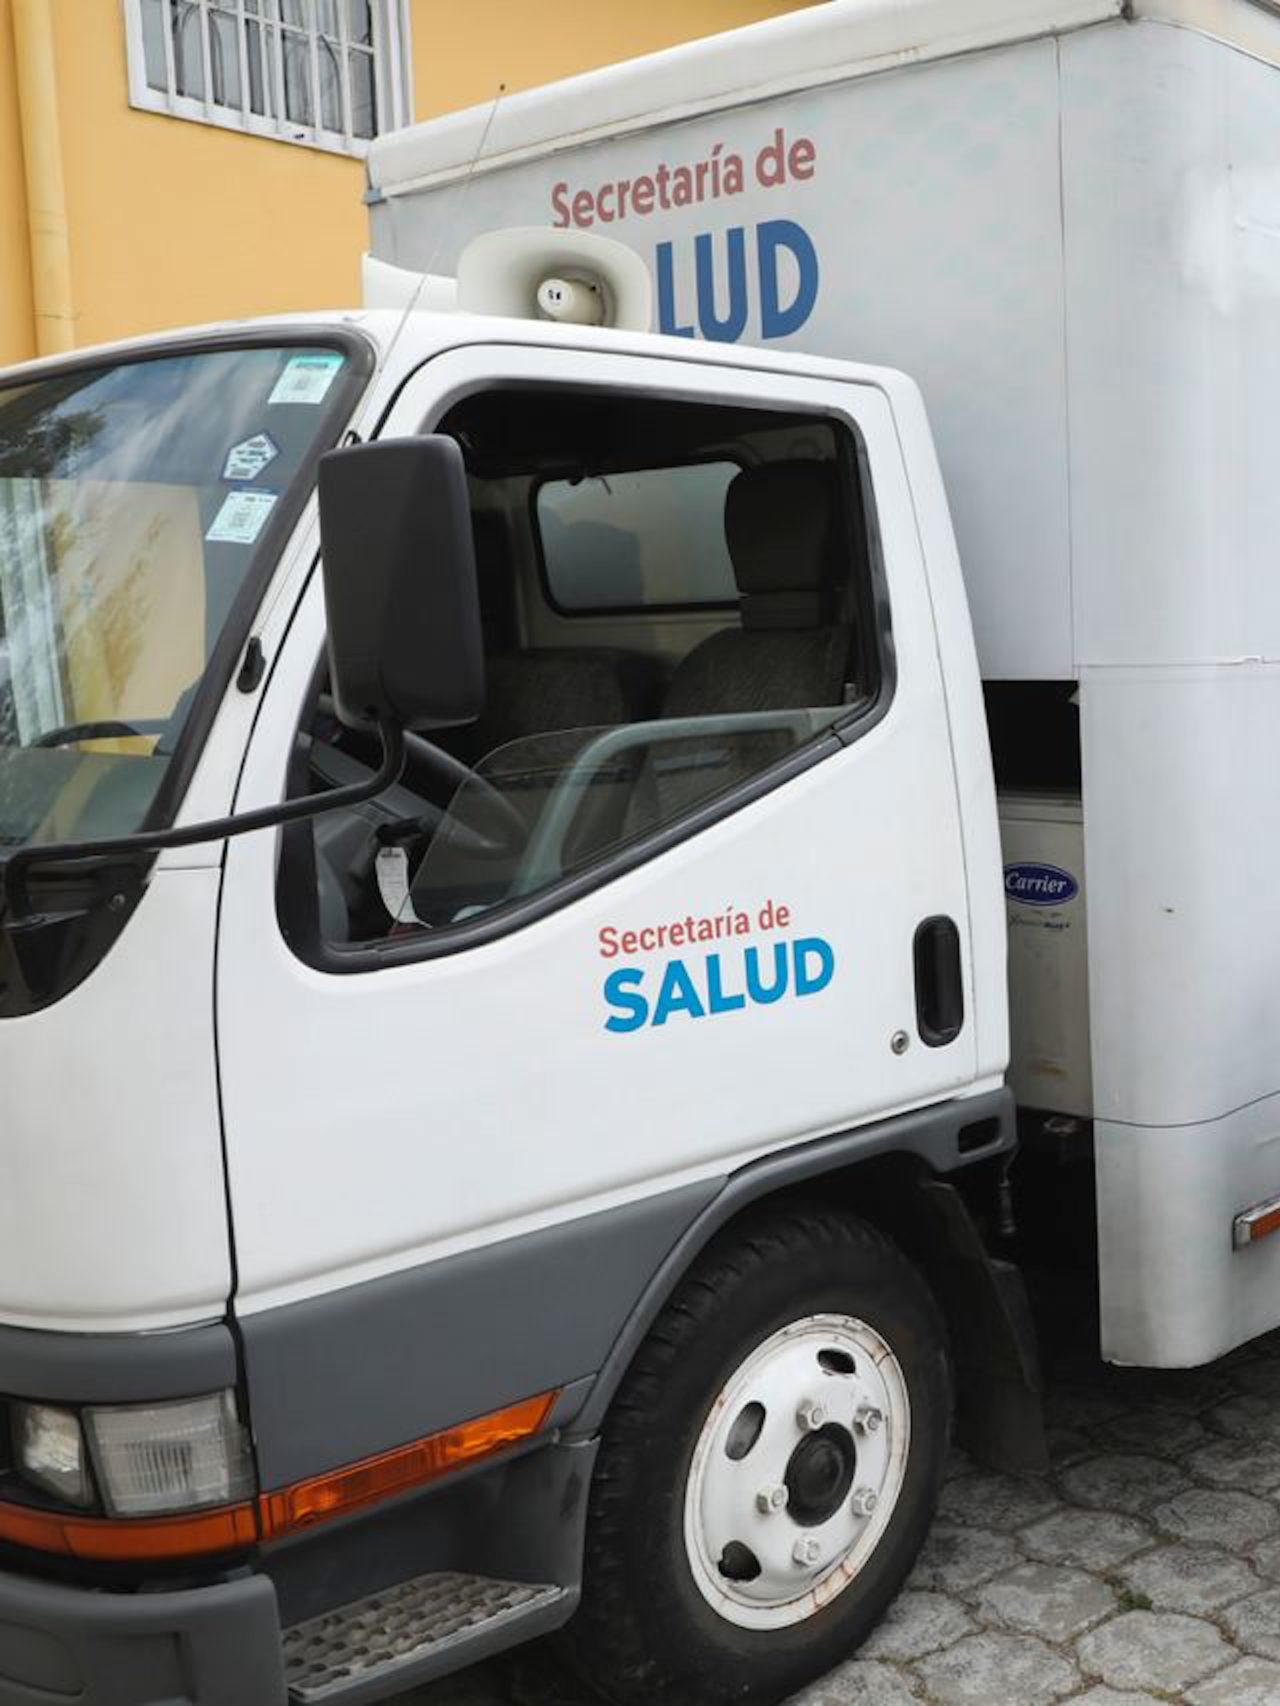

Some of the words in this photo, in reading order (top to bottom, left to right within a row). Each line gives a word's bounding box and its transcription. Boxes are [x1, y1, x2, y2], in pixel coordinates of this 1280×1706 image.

[551, 144, 744, 229] Secretaría
[755, 128, 816, 188] de
[655, 219, 819, 344] LUD
[599, 906, 750, 959] Secretaría
[758, 899, 790, 930] de
[1005, 871, 1067, 894] Carrier
[603, 936, 836, 1034] SALUD
